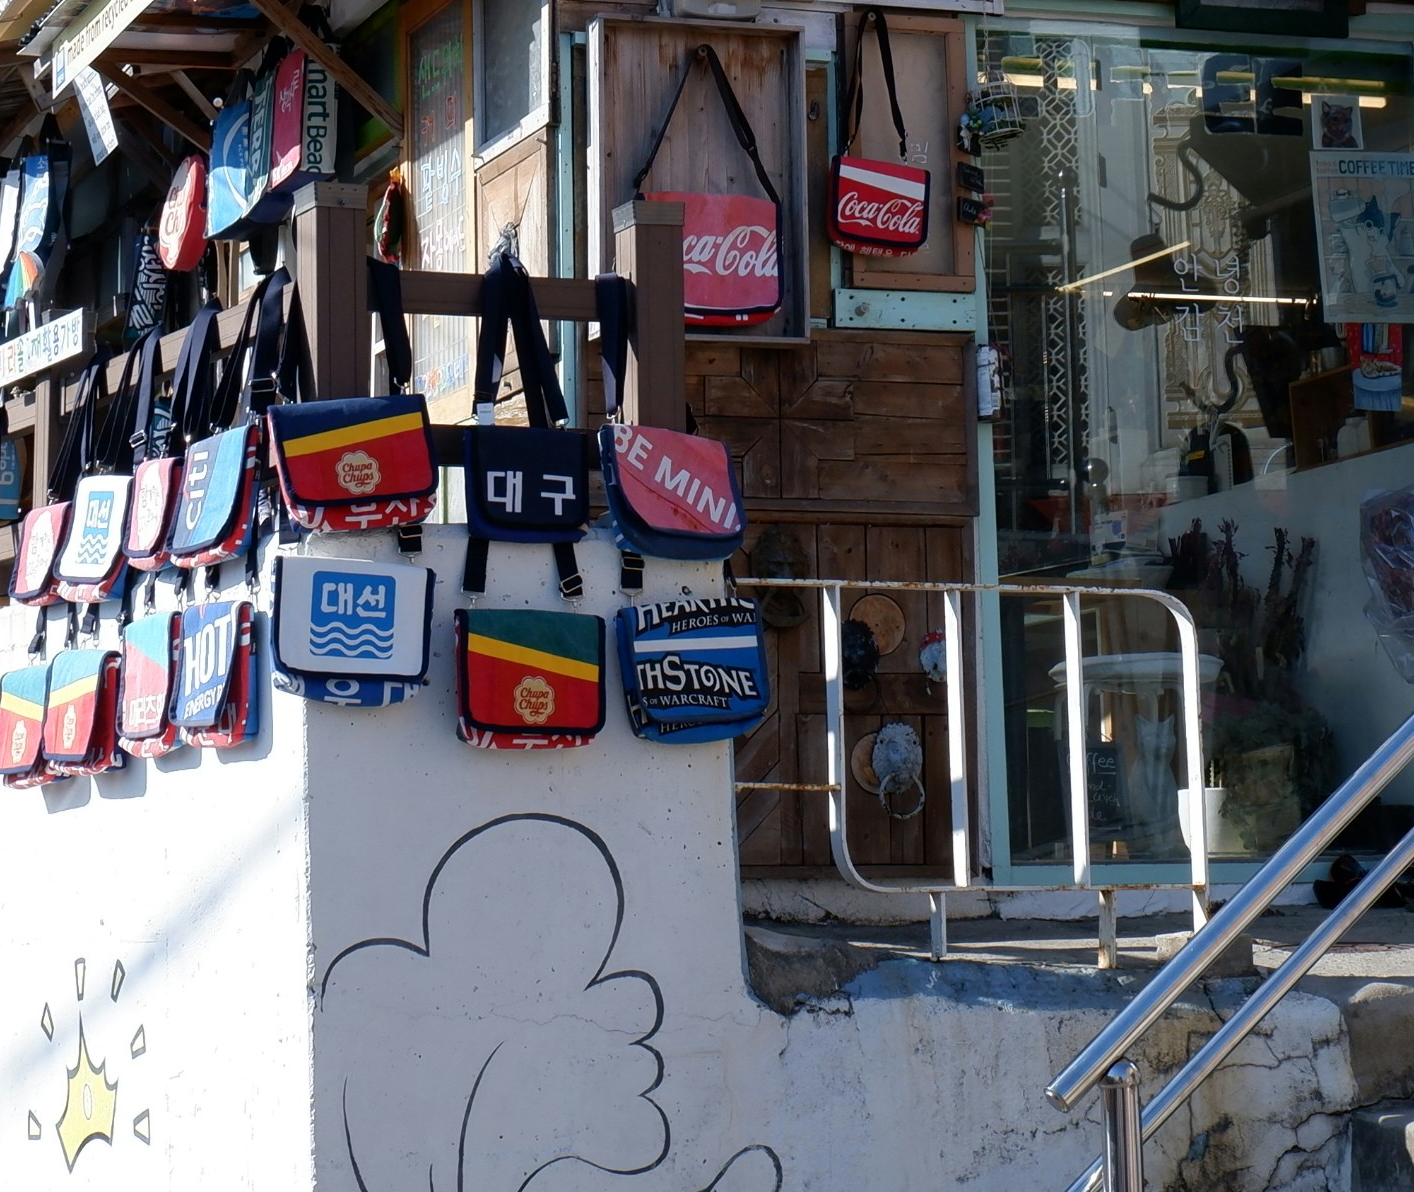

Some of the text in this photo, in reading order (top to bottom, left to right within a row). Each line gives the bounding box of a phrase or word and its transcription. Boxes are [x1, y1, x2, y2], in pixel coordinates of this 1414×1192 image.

[1338, 159, 1386, 175] COFFEE
[342, 461, 373, 476] Chupa
[342, 471, 374, 488] Chups
[320, 582, 387, 618] 대선
[672, 615, 719, 633] HEROES
[520, 687, 549, 701] Chupa
[518, 698, 549, 716] Chups
